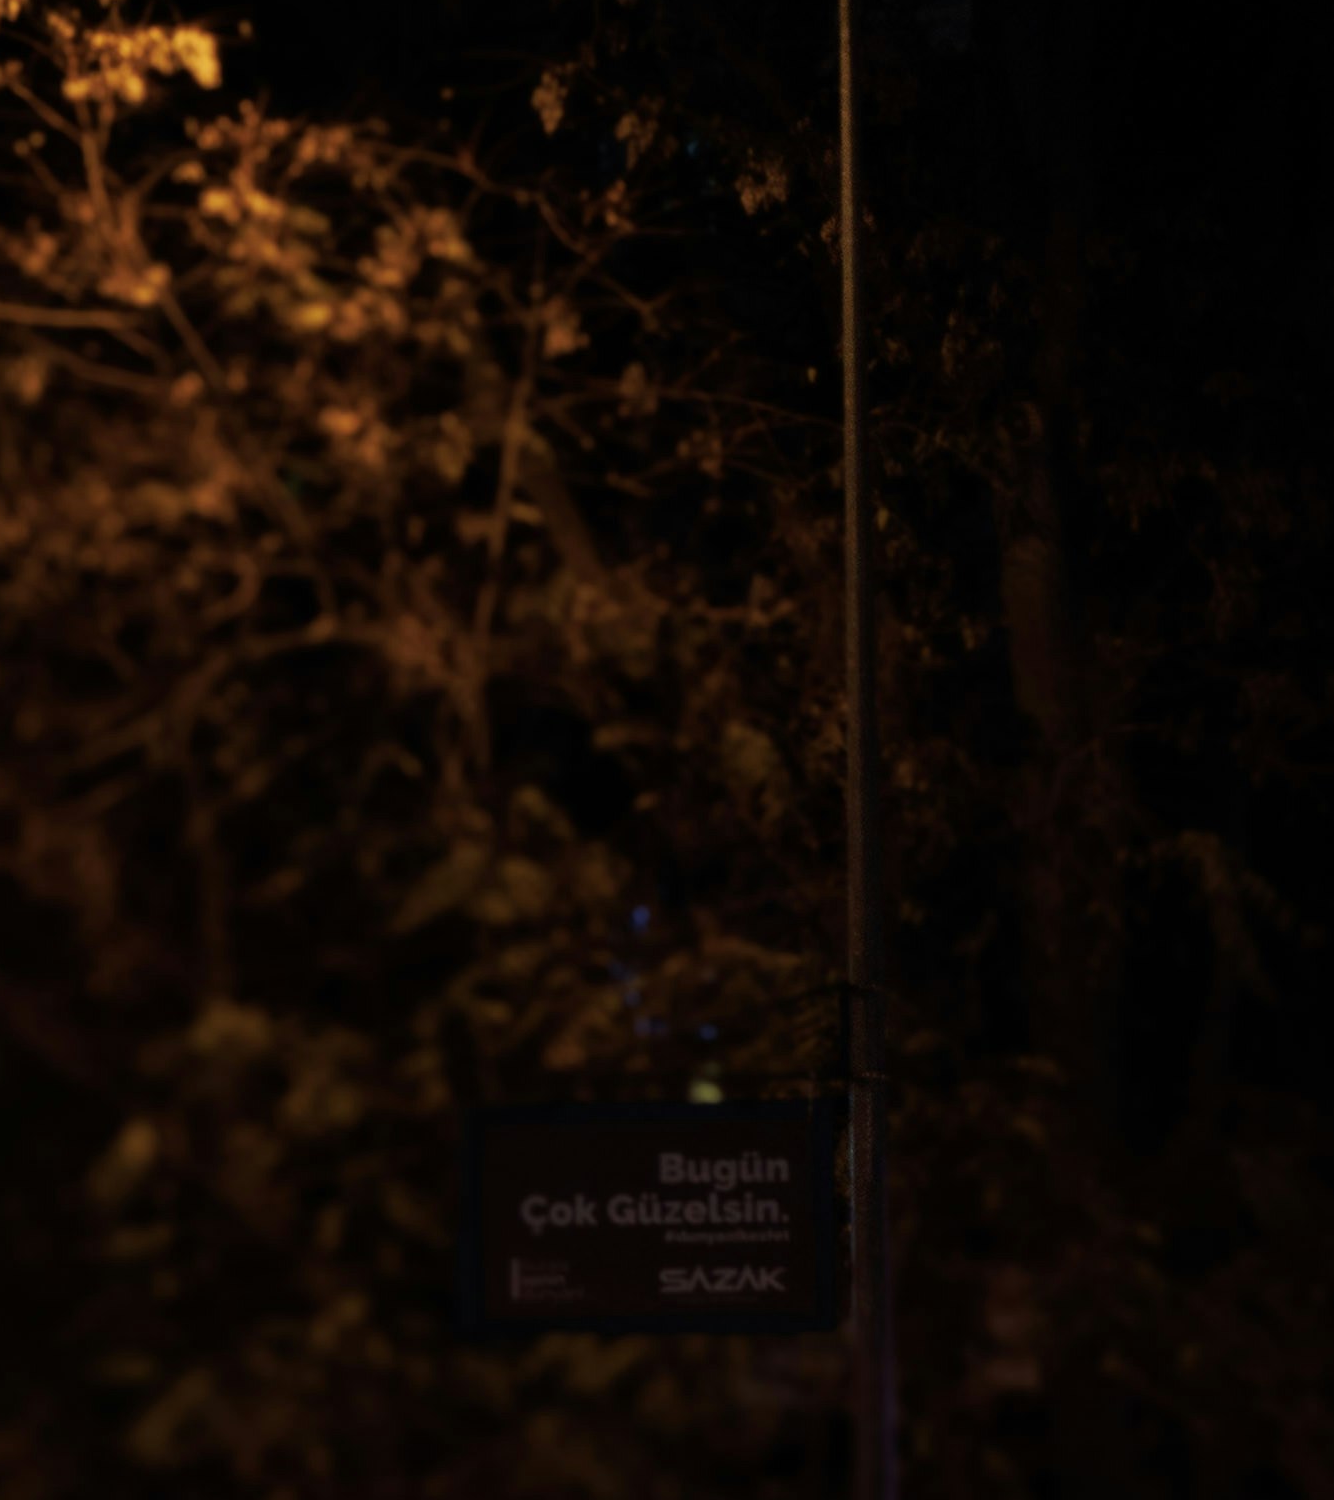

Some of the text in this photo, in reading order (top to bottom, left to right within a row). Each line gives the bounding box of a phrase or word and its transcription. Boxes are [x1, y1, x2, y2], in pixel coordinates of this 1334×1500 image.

[659, 1152, 790, 1192] Bugün
[520, 1193, 790, 1235] Çok Güzelsin.
[659, 1264, 788, 1293] SAZAK
